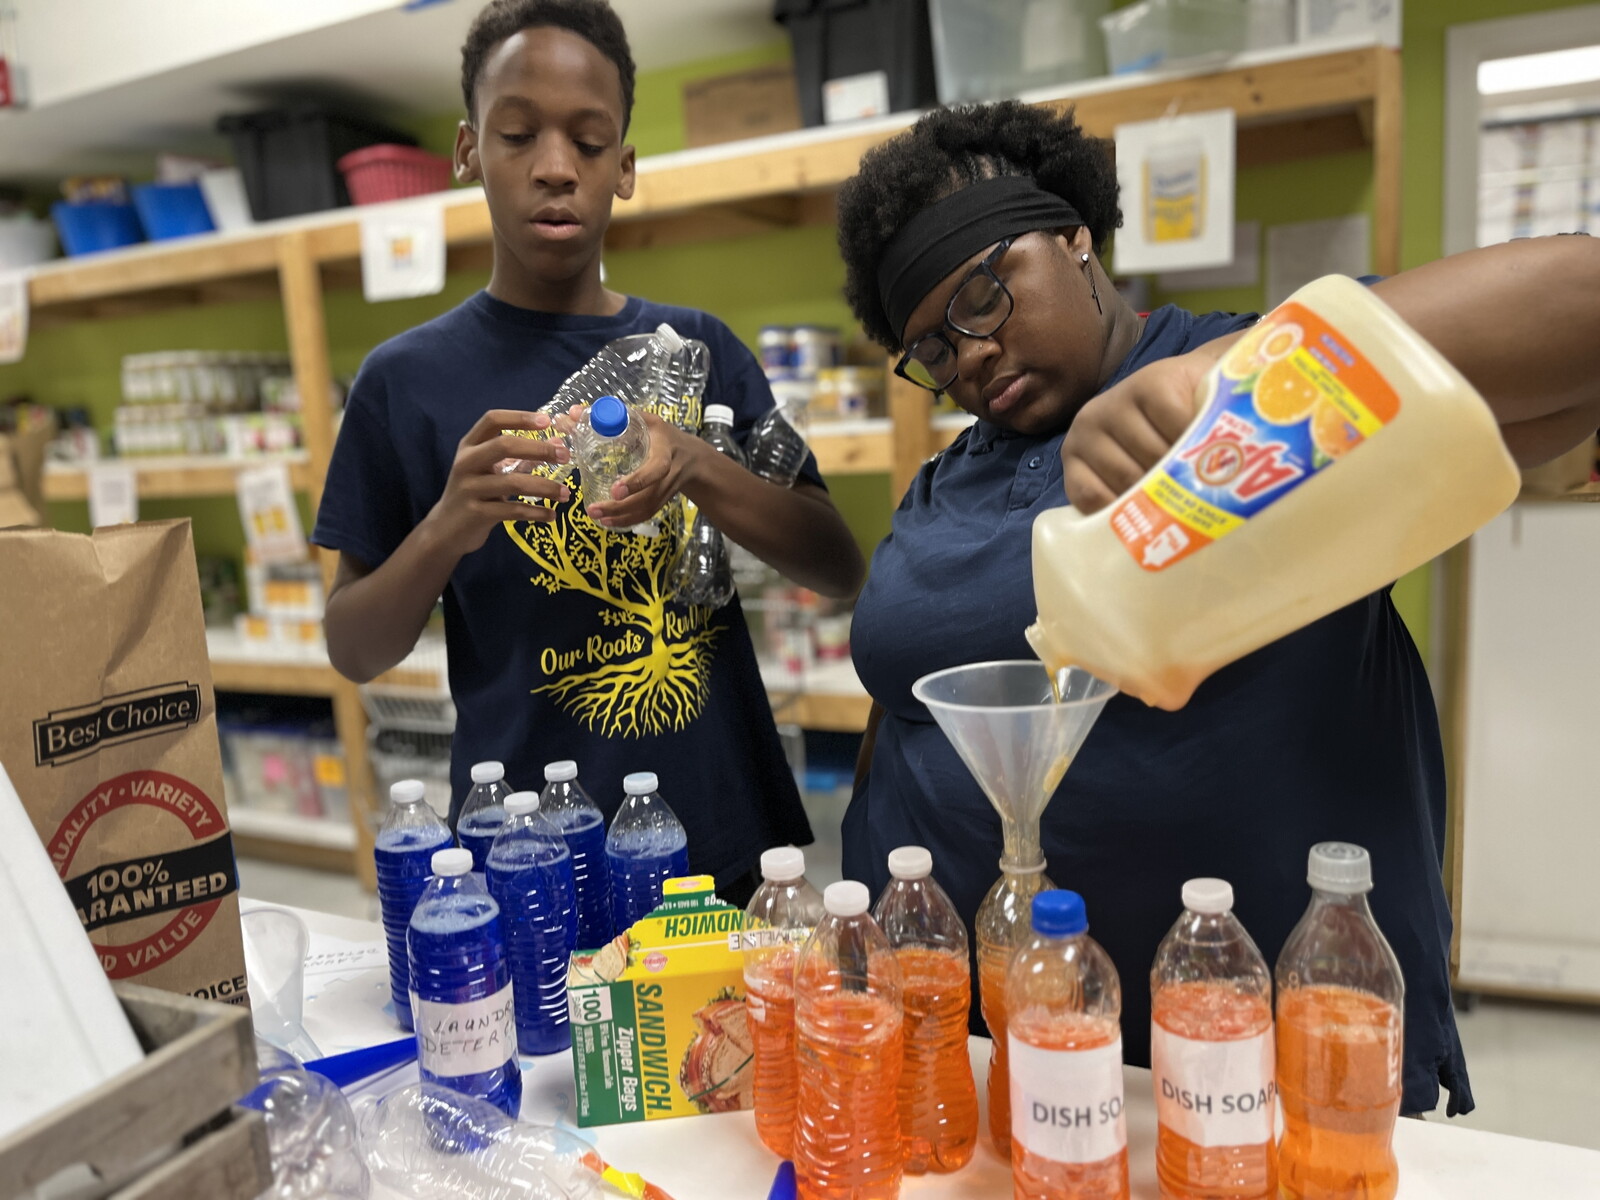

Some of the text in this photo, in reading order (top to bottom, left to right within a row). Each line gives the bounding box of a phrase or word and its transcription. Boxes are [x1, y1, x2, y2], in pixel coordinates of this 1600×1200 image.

[540, 647, 584, 675] Our
[586, 629, 645, 664] Roots
[48, 698, 190, 753] Best Choice
[131, 780, 212, 829] VARIETY
[87, 859, 170, 898] 100%
[127, 909, 203, 968] VALUE
[186, 975, 247, 999] OICE
[582, 989, 602, 1022] 100
[616, 1027, 638, 1112] Zipper Bags
[636, 983, 672, 1111] SANDWICH
[1033, 1096, 1125, 1128] DISH SO
[1162, 1078, 1275, 1114] DISH SOAP
